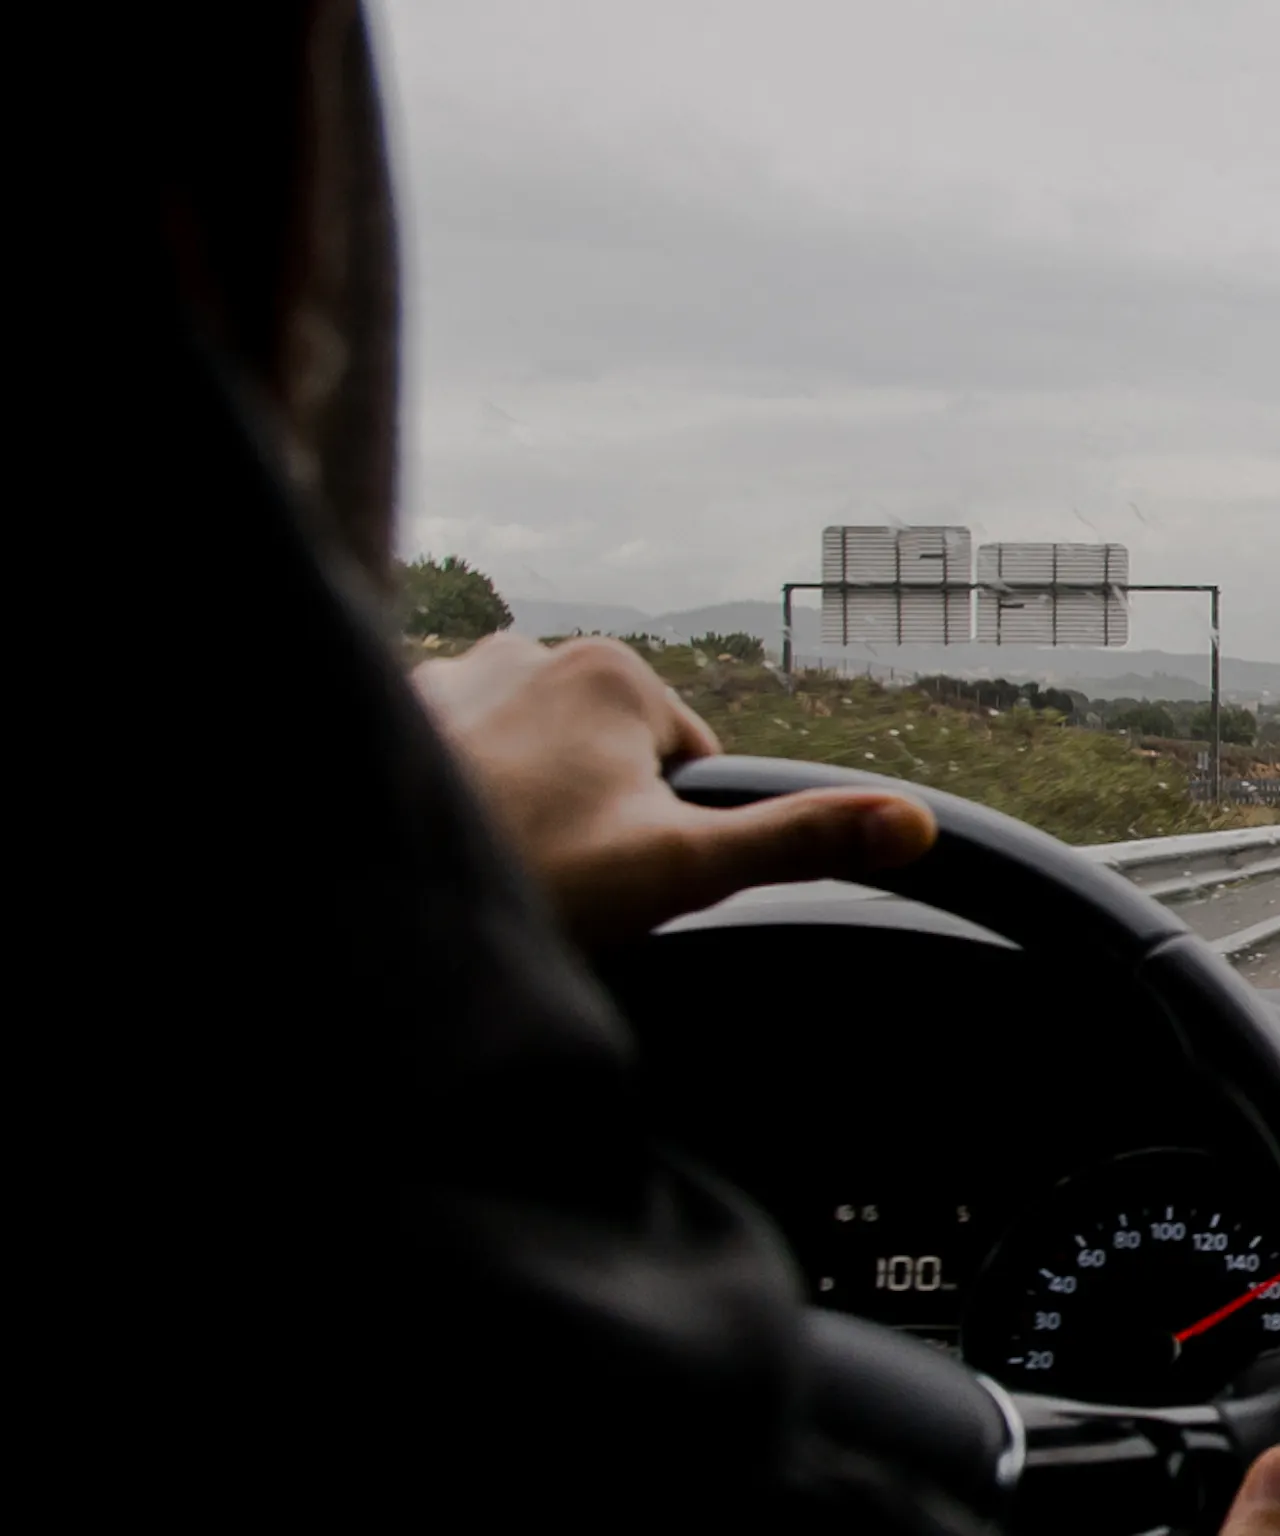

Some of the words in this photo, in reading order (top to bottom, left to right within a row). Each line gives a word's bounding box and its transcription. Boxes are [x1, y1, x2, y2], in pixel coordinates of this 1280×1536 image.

[1113, 1231, 1141, 1249] 80
[1150, 1222, 1186, 1241] 100
[1192, 1232, 1228, 1251] 120
[1077, 1249, 1106, 1267] 60
[1224, 1254, 1260, 1272] 140
[875, 1255, 942, 1292] 100
[1048, 1275, 1077, 1294] 40
[1034, 1312, 1061, 1331] 30
[1025, 1350, 1054, 1369] 20
